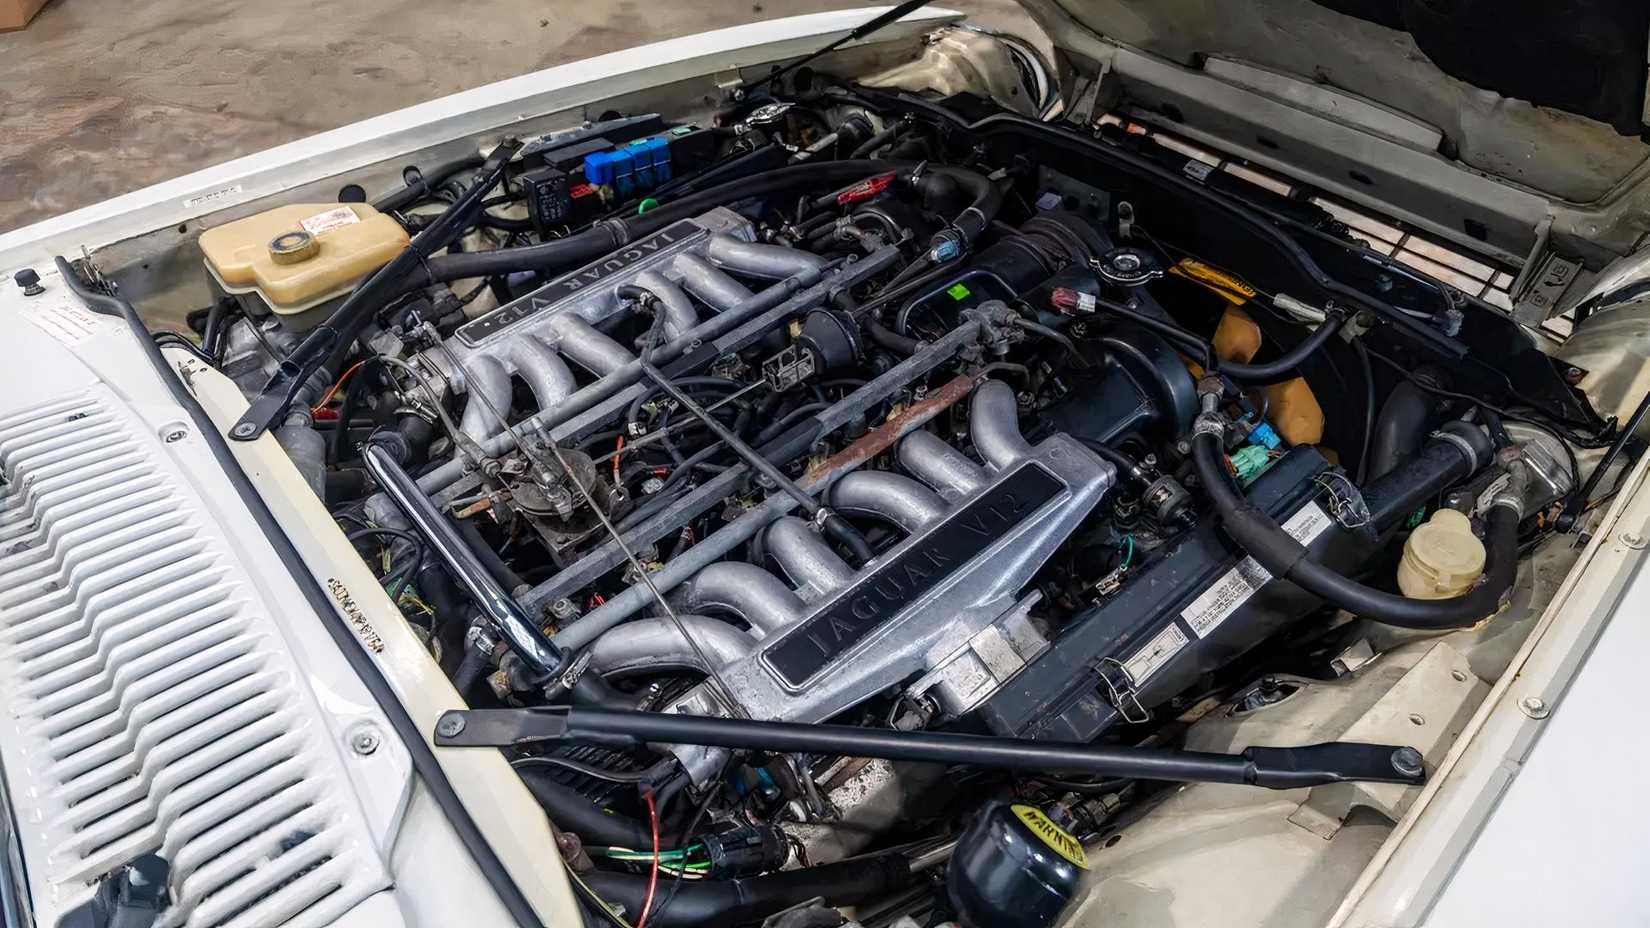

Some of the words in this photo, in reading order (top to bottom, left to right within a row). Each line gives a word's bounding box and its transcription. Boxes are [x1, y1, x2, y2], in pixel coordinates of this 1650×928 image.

[561, 232, 675, 291] JAGUAR
[493, 296, 550, 326] V12
[807, 549, 951, 657] JAGUAR
[959, 493, 1026, 537] V12
